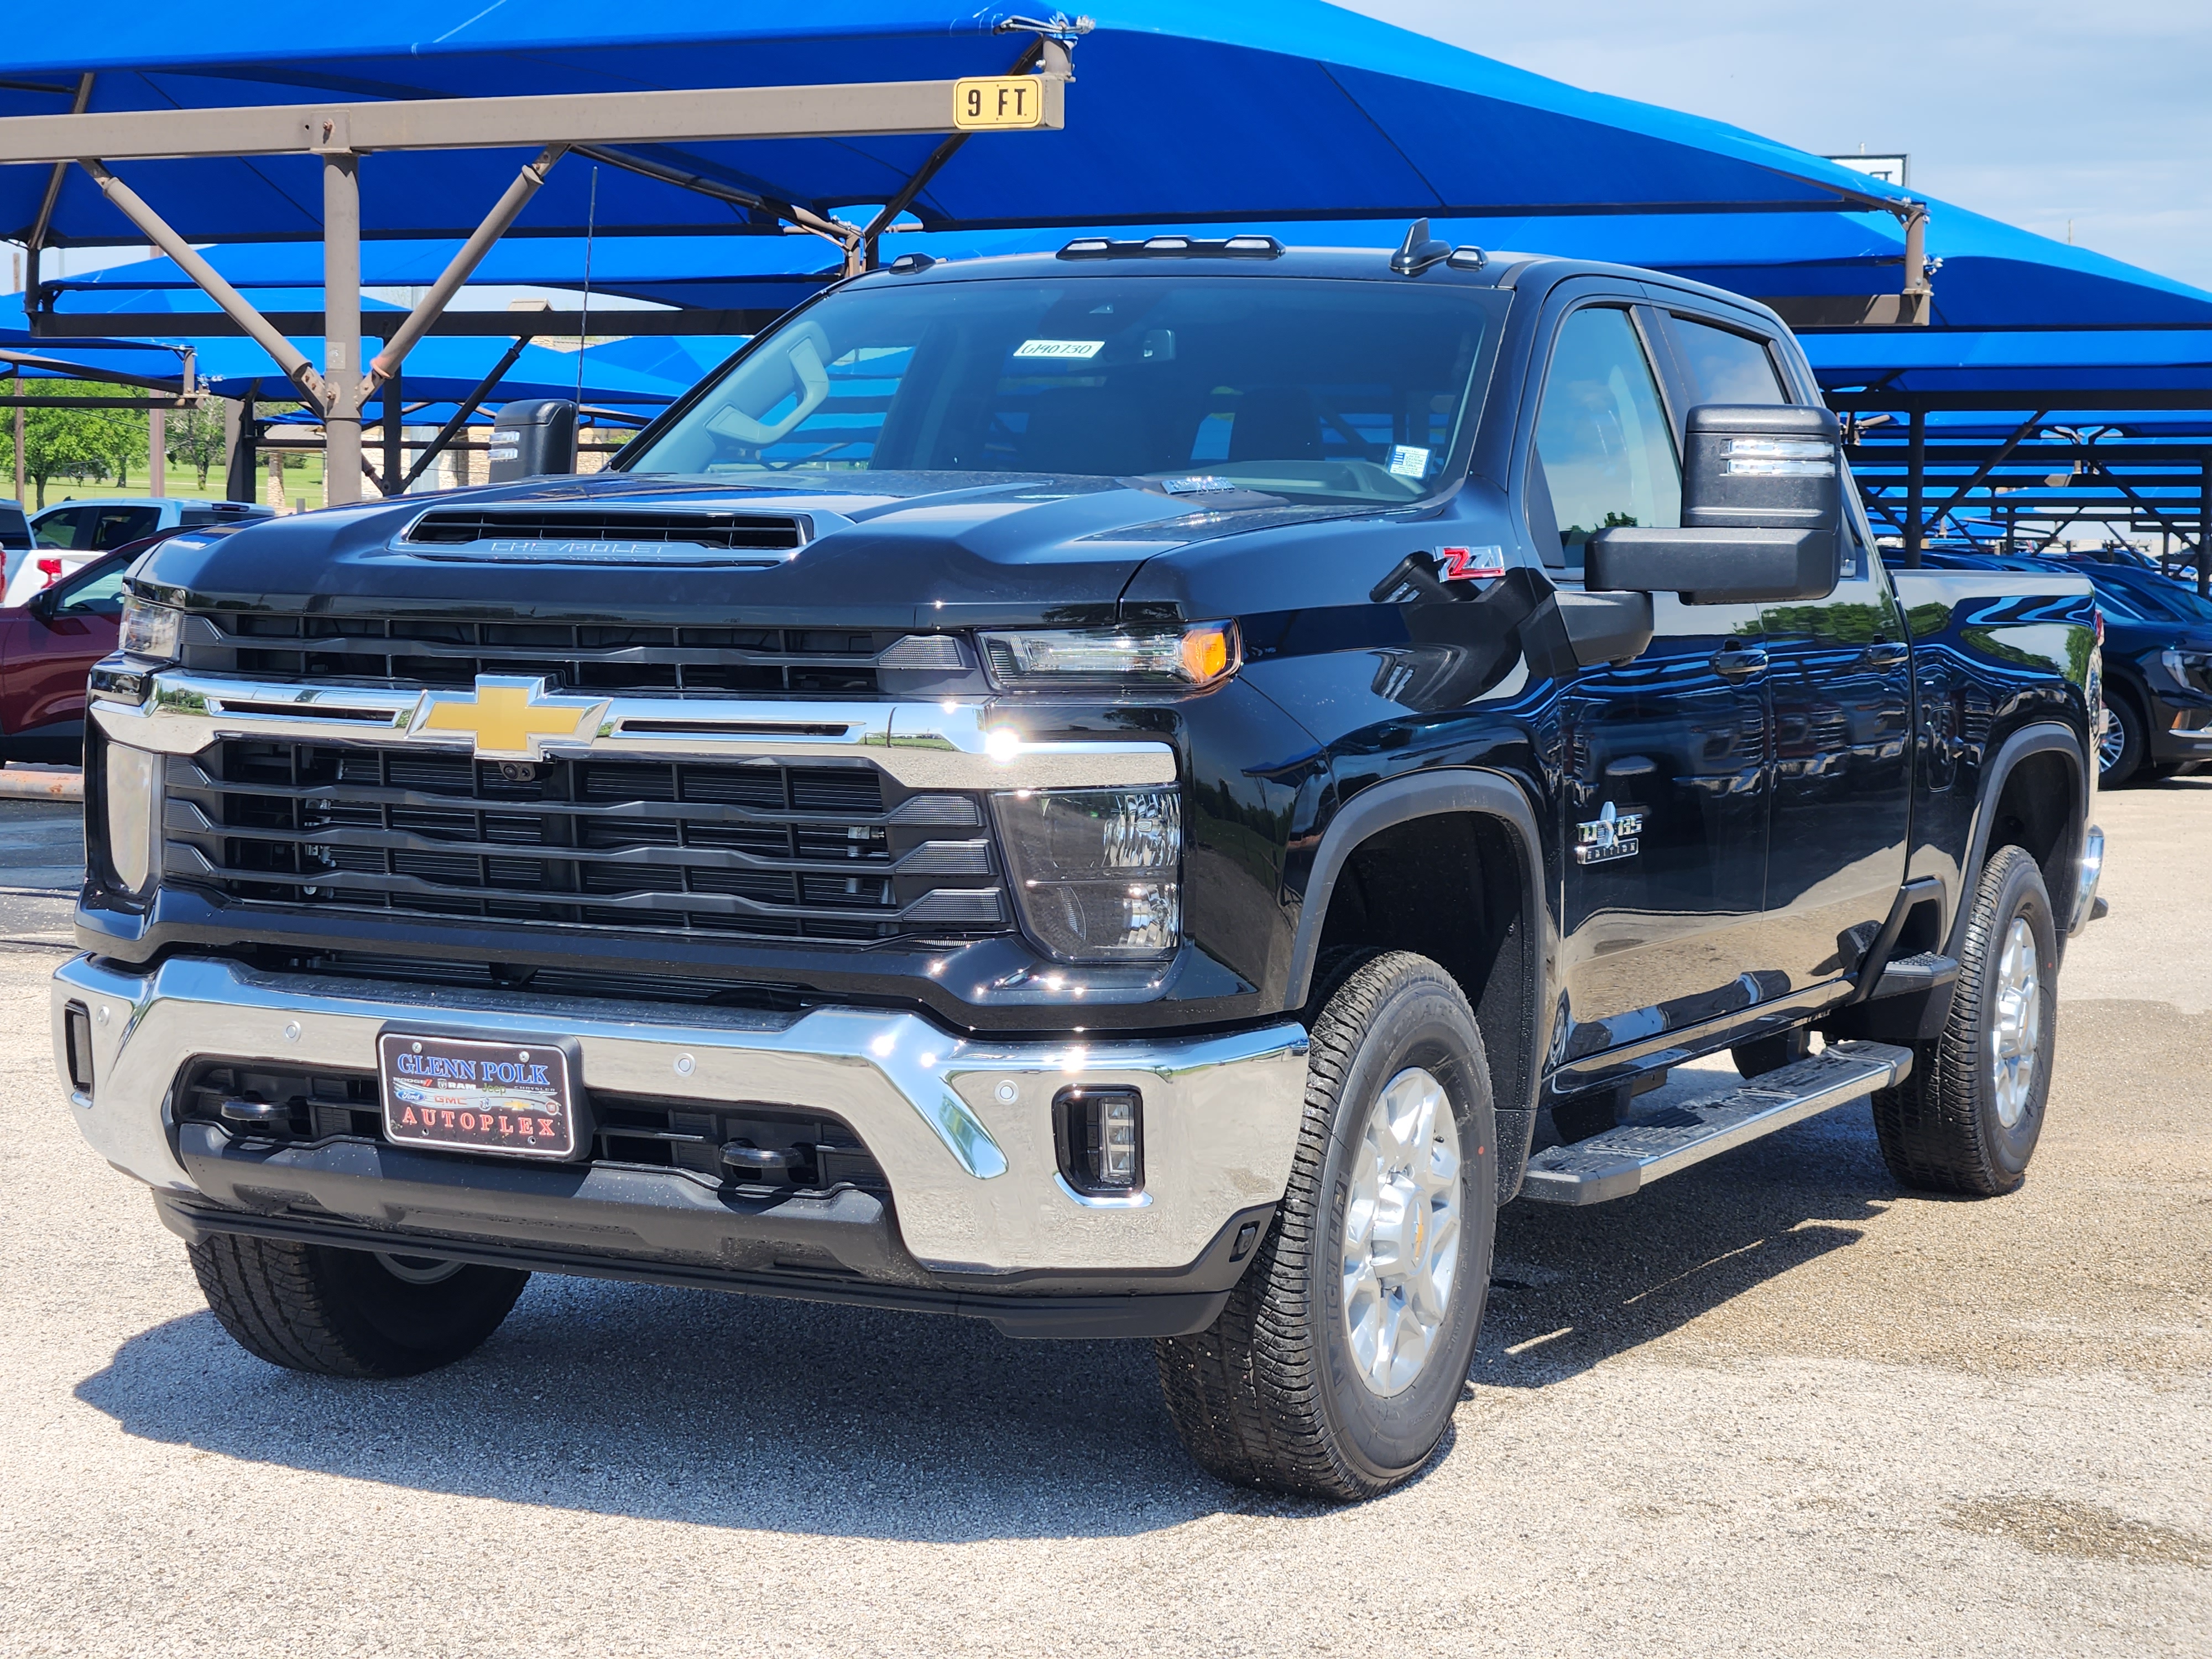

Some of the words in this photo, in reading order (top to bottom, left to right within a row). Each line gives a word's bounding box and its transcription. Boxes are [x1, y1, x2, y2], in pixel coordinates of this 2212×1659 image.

[968, 89, 981, 117] 9
[491, 542, 672, 554] CHEVROLET
[1576, 814, 1643, 844] TEAS
[1587, 842, 1636, 860] EDITION
[397, 1053, 476, 1081] GLENN
[481, 1061, 550, 1086] POLK
[448, 1082, 477, 1090] RAM
[482, 1083, 507, 1095] Jeep
[401, 1091, 420, 1100] Ford
[434, 1095, 468, 1105] GMC
[402, 1107, 555, 1136] AUTOPLEX
[1327, 1185, 1345, 1346] MICHELIN
